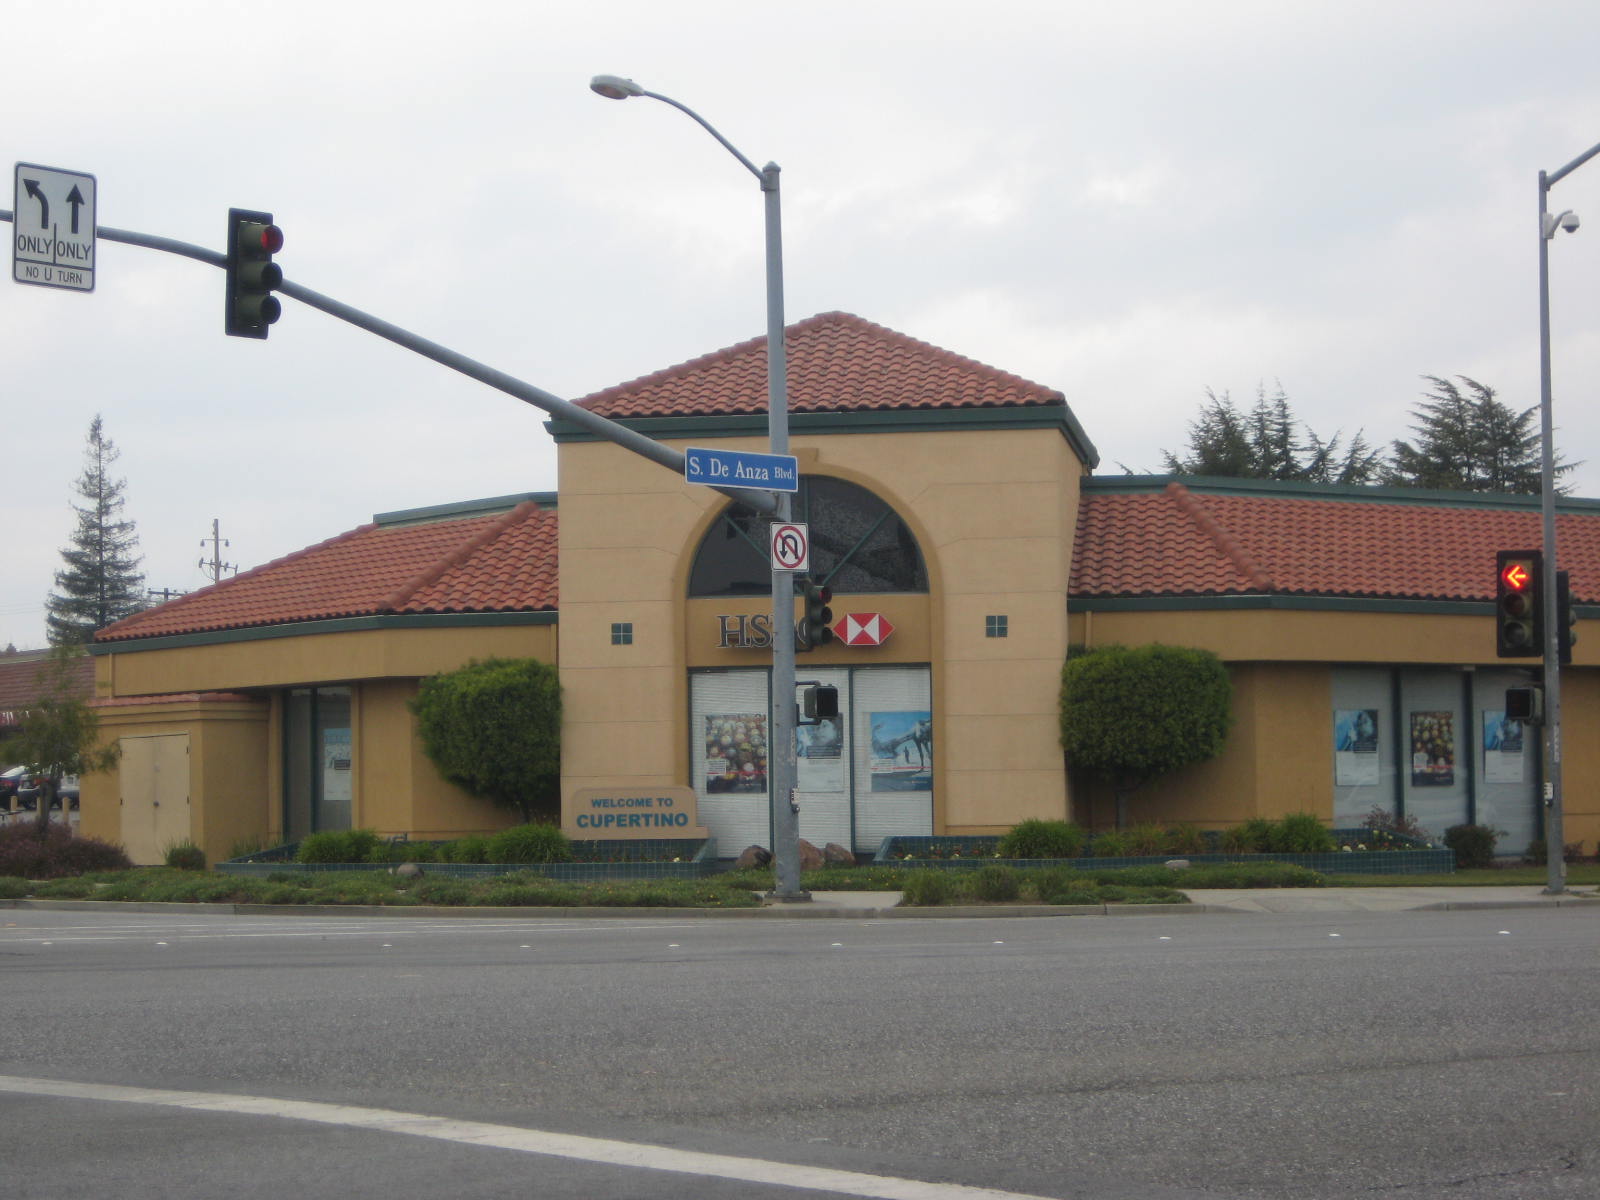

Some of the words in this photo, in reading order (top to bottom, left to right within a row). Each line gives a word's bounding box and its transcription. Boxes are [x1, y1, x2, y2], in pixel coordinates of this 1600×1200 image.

[17, 234, 53, 255] ONLY
[56, 240, 92, 261] ONLY
[25, 265, 39, 279] NO
[44, 268, 52, 281] U
[57, 270, 83, 284] TURN
[689, 456, 704, 476] S.
[710, 458, 729, 477] De
[735, 460, 769, 481] Anza
[716, 614, 812, 648] HS
[591, 797, 653, 808] WELCOME
[656, 797, 674, 807] TO
[576, 812, 689, 829] CUPERTINO
